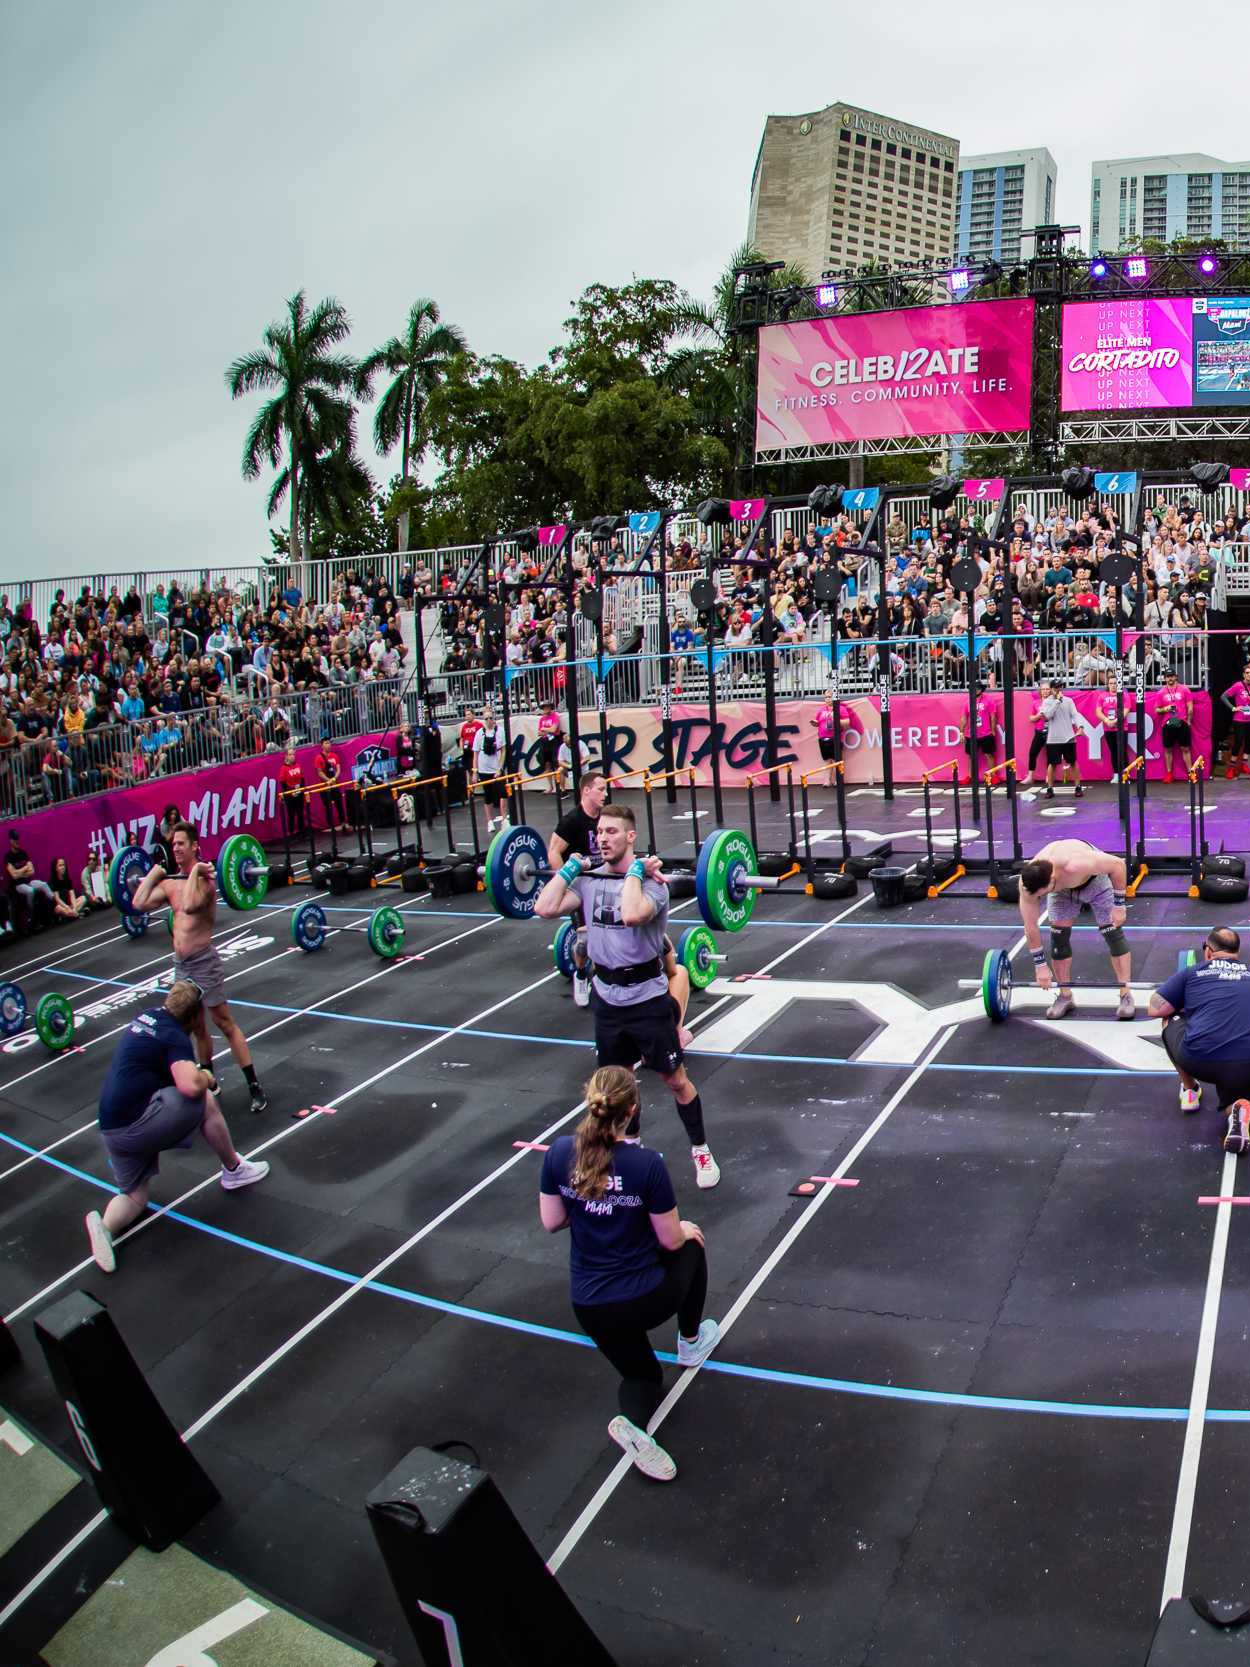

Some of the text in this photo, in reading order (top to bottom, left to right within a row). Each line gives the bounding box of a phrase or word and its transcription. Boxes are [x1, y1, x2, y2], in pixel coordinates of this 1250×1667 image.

[1098, 308, 1150, 320] UP NEXT
[1098, 320, 1150, 331] UP NEXT
[1097, 337, 1152, 349] ELITE MEN
[1068, 347, 1181, 373] CORTADITO
[1098, 379, 1150, 389] UP NEXT
[775, 378, 1013, 411] FITNESS. COMMUNITY. LIFE.
[1098, 391, 1150, 400] UP NEXT
[977, 481, 988, 498] 5
[1108, 475, 1119, 491] 6
[854, 492, 865, 506] 4
[740, 503, 750, 518] 3
[639, 515, 648, 529] 2
[548, 527, 557, 542] 1
[1136, 663, 1144, 703] ROGUE
[880, 674, 888, 711] ROGUE
[648, 716, 800, 776] STAGE
[843, 724, 962, 751] OWERED
[188, 775, 277, 839] MIAMI
[504, 834, 538, 867] ROGUE
[726, 839, 754, 873] ROGUE
[717, 889, 746, 923] ROGUE
[1209, 960, 1248, 970] JUDGE
[684, 976, 1178, 1073] TYR
